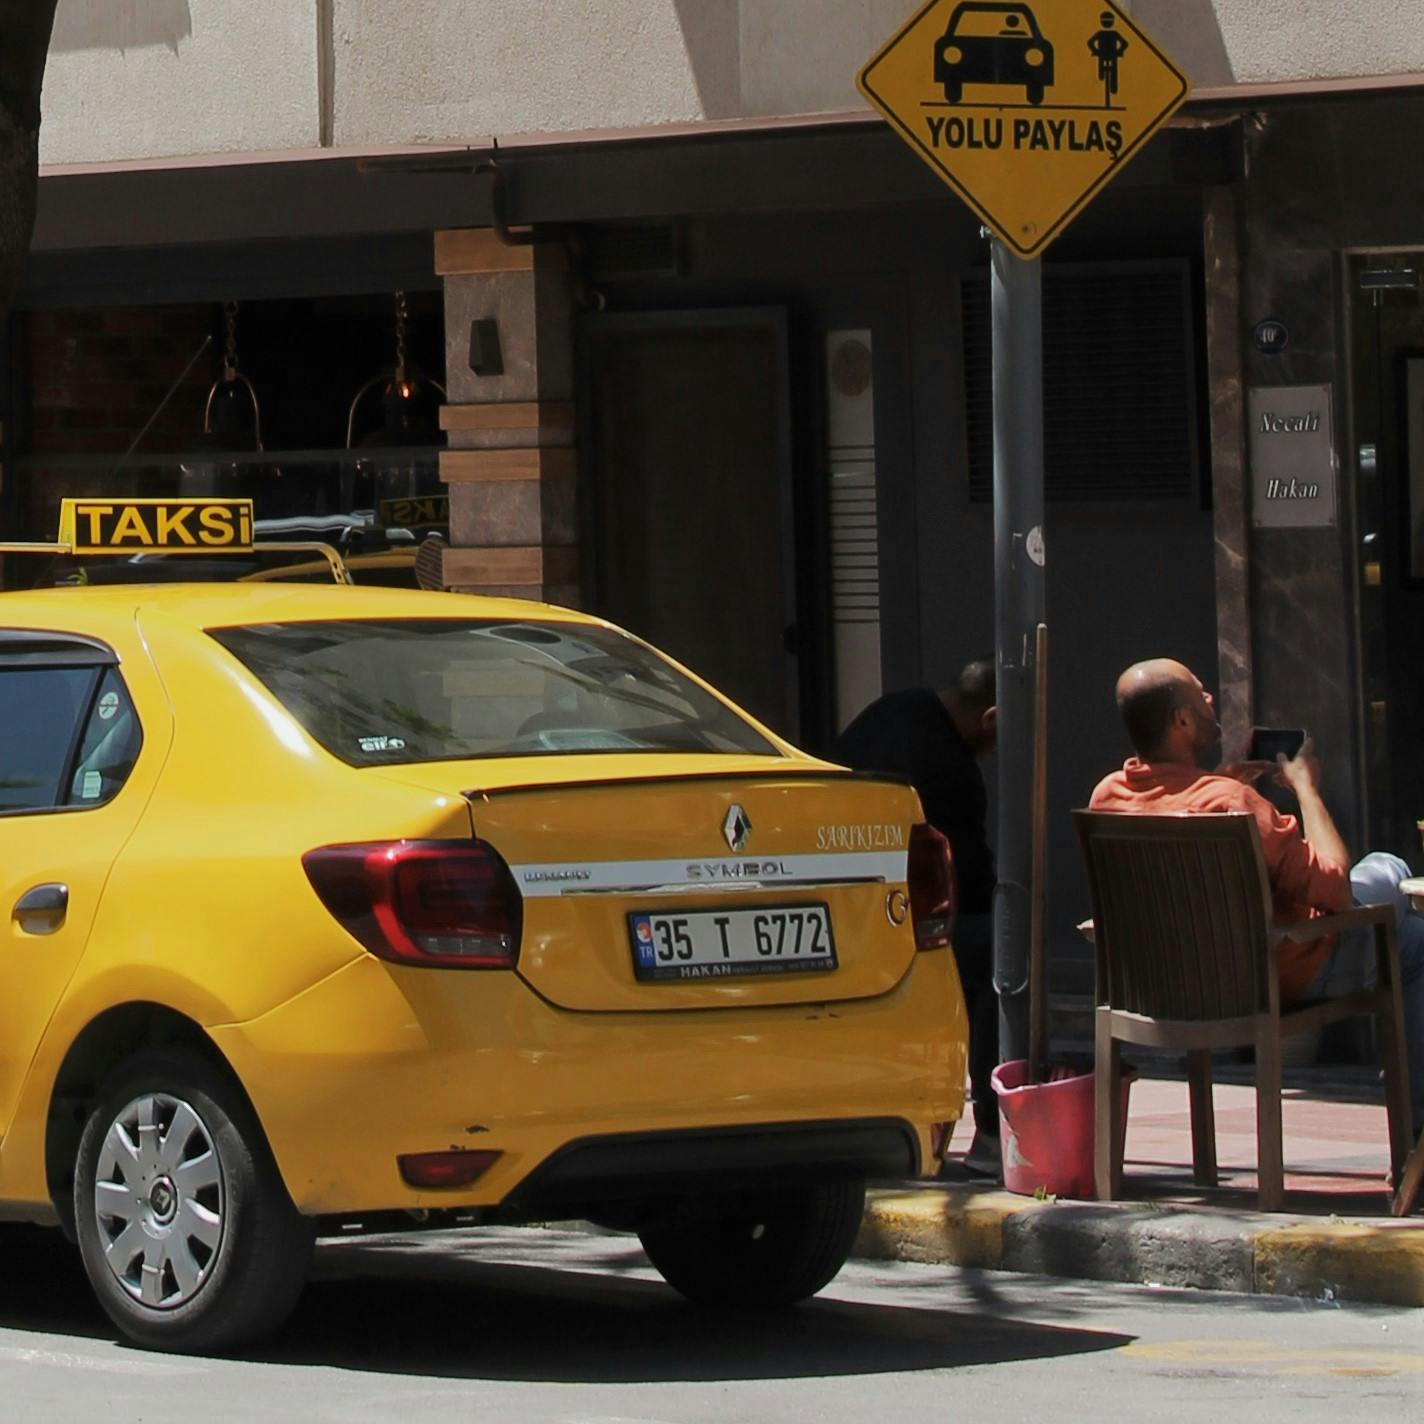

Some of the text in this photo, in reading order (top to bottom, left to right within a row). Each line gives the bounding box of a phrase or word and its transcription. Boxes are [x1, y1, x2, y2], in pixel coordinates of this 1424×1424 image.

[926, 116, 1123, 160] YOLU PAYLAŞ
[1266, 478, 1319, 499] Hakan
[686, 861, 793, 880] SYMBOL
[654, 913, 826, 961] 35 T 6772
[639, 946, 654, 958] TR
[680, 964, 731, 977] HAKAN
